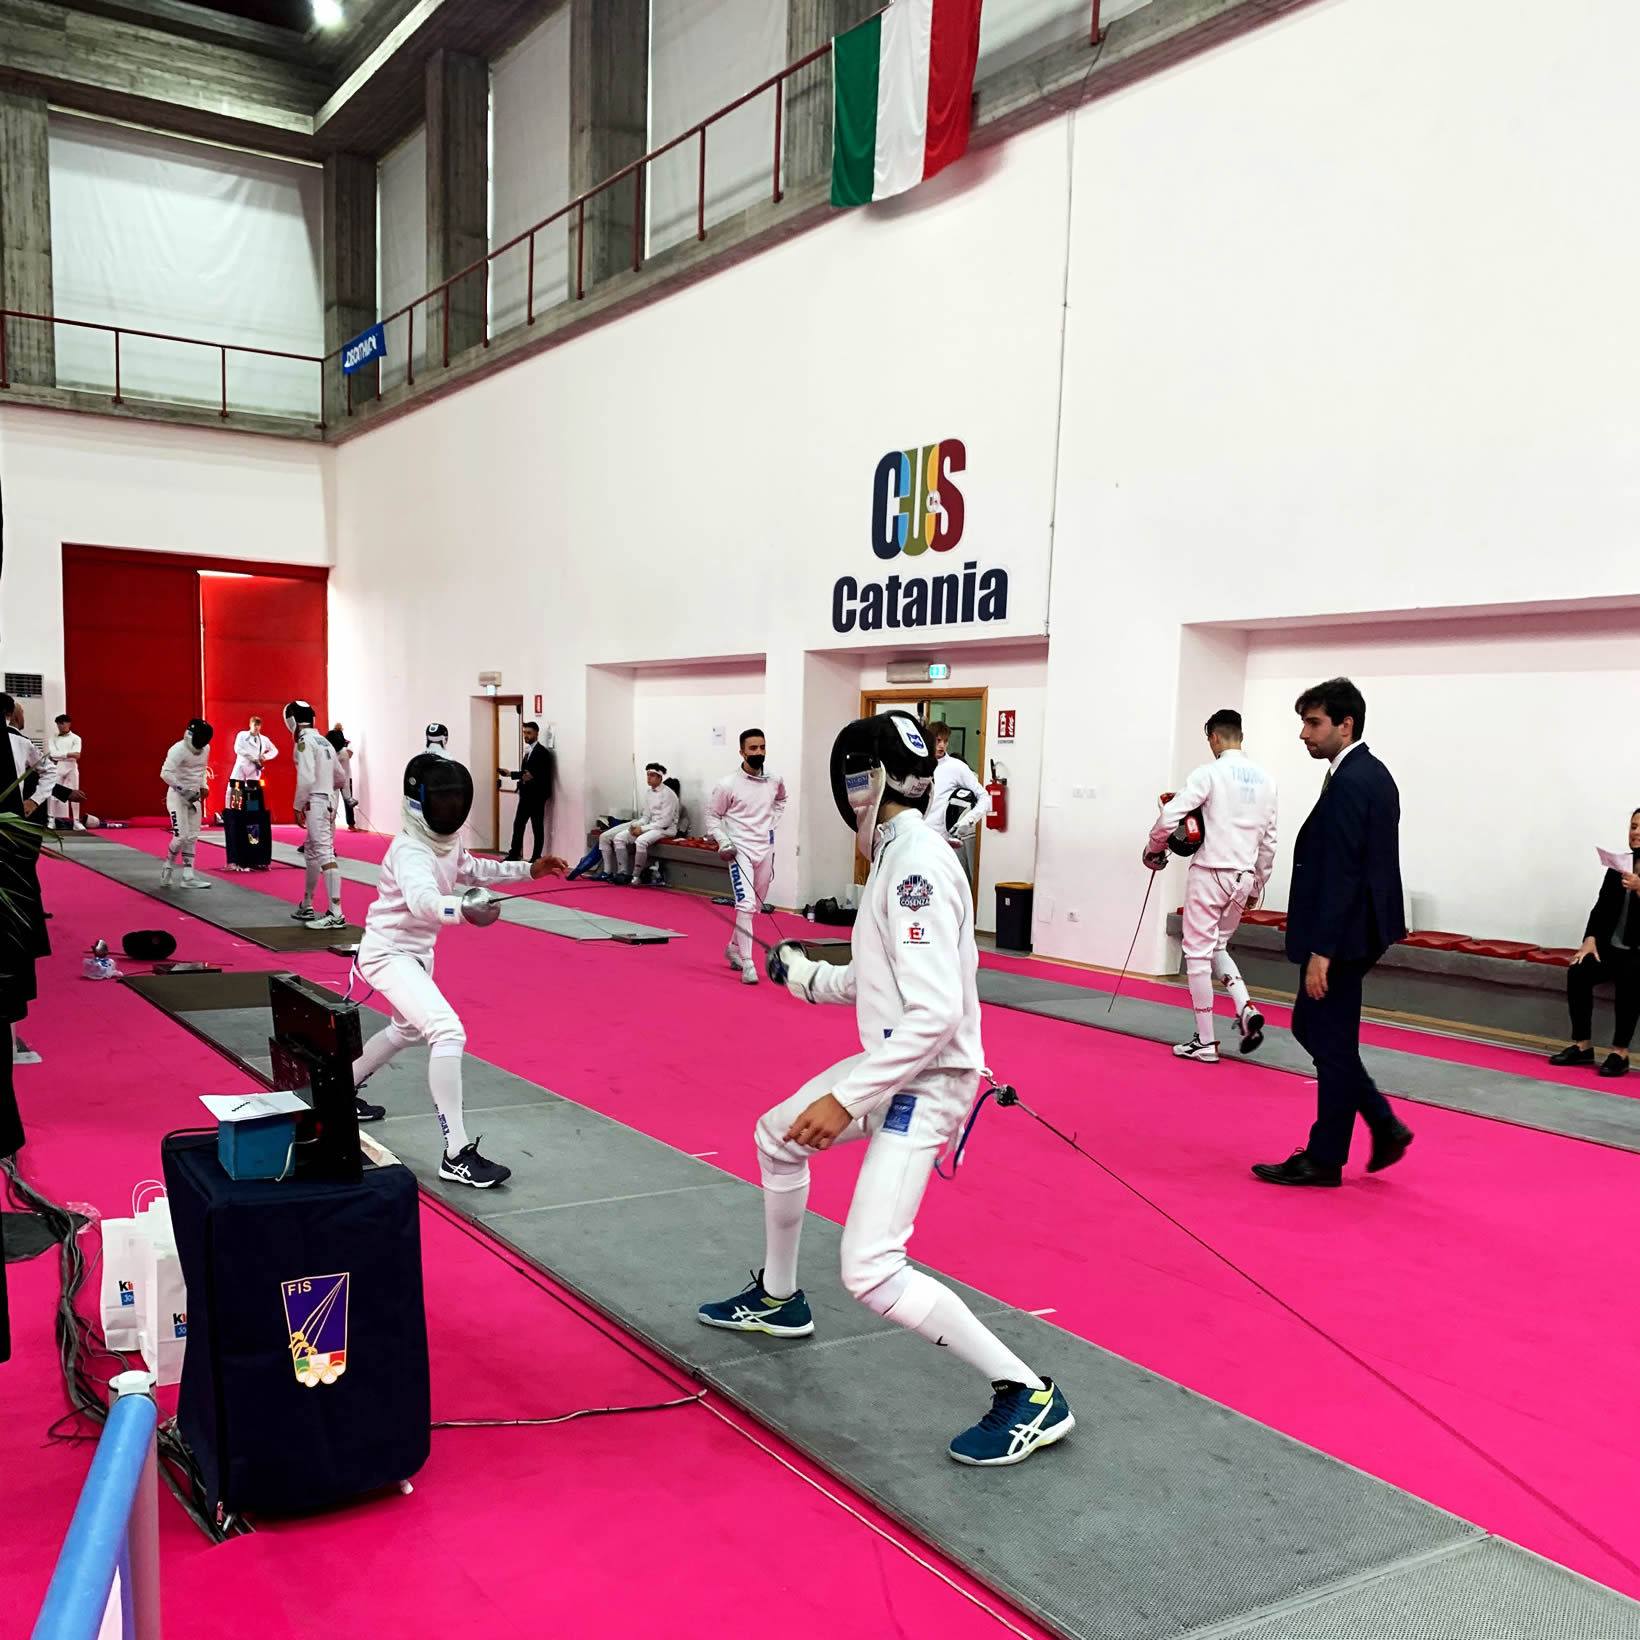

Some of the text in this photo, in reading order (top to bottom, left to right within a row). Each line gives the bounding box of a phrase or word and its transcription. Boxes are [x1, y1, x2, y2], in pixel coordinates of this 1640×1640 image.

[872, 438, 966, 559] CUS
[832, 561, 1008, 633] Catania
[730, 863, 746, 902] ITALIA
[900, 897, 930, 908] COSENZA
[287, 1280, 313, 1296] FIS
